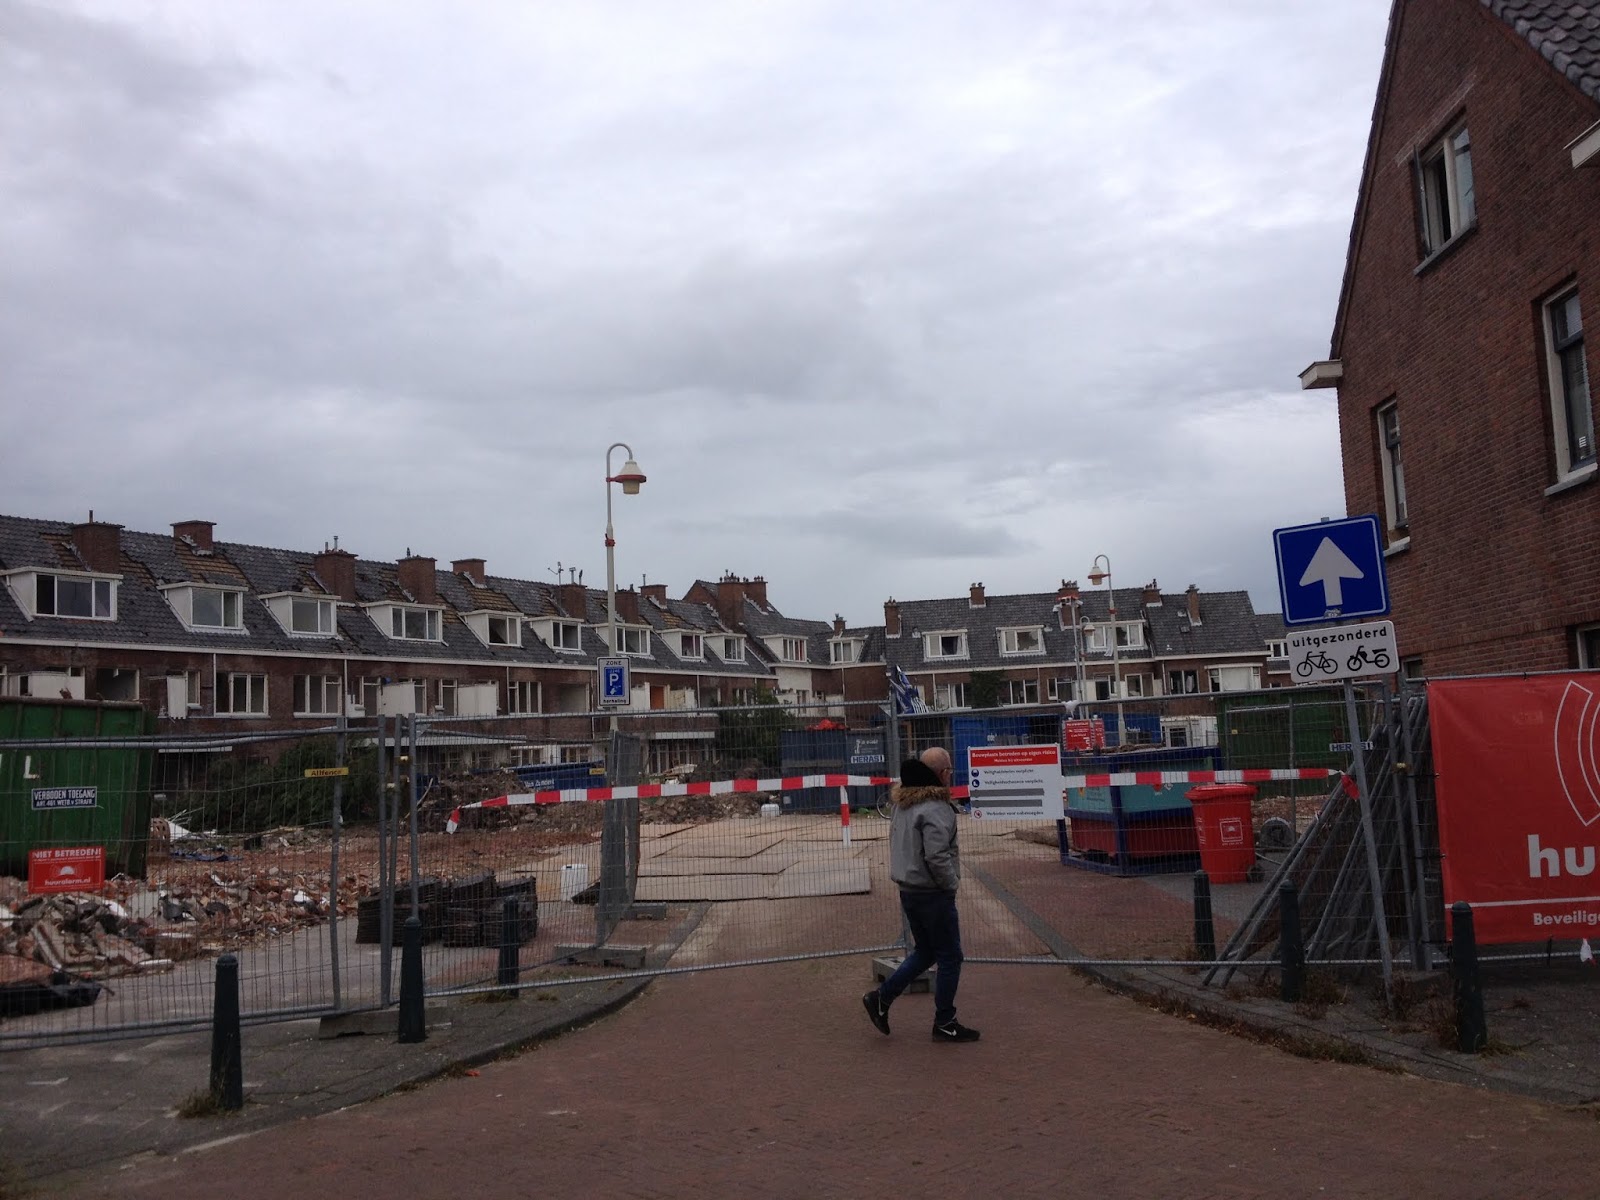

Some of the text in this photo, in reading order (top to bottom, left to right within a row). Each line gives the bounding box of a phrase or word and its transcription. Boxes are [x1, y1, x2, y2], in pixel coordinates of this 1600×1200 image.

[1292, 626, 1388, 648] uitgezonderd
[609, 673, 619, 687] P
[1331, 742, 1367, 752] HERS
[34, 789, 95, 800] VERBODEN TOEGANG
[32, 848, 101, 858] NIET BETREDEN!
[1527, 833, 1596, 878] hu
[1533, 909, 1600, 926] Beveilig
